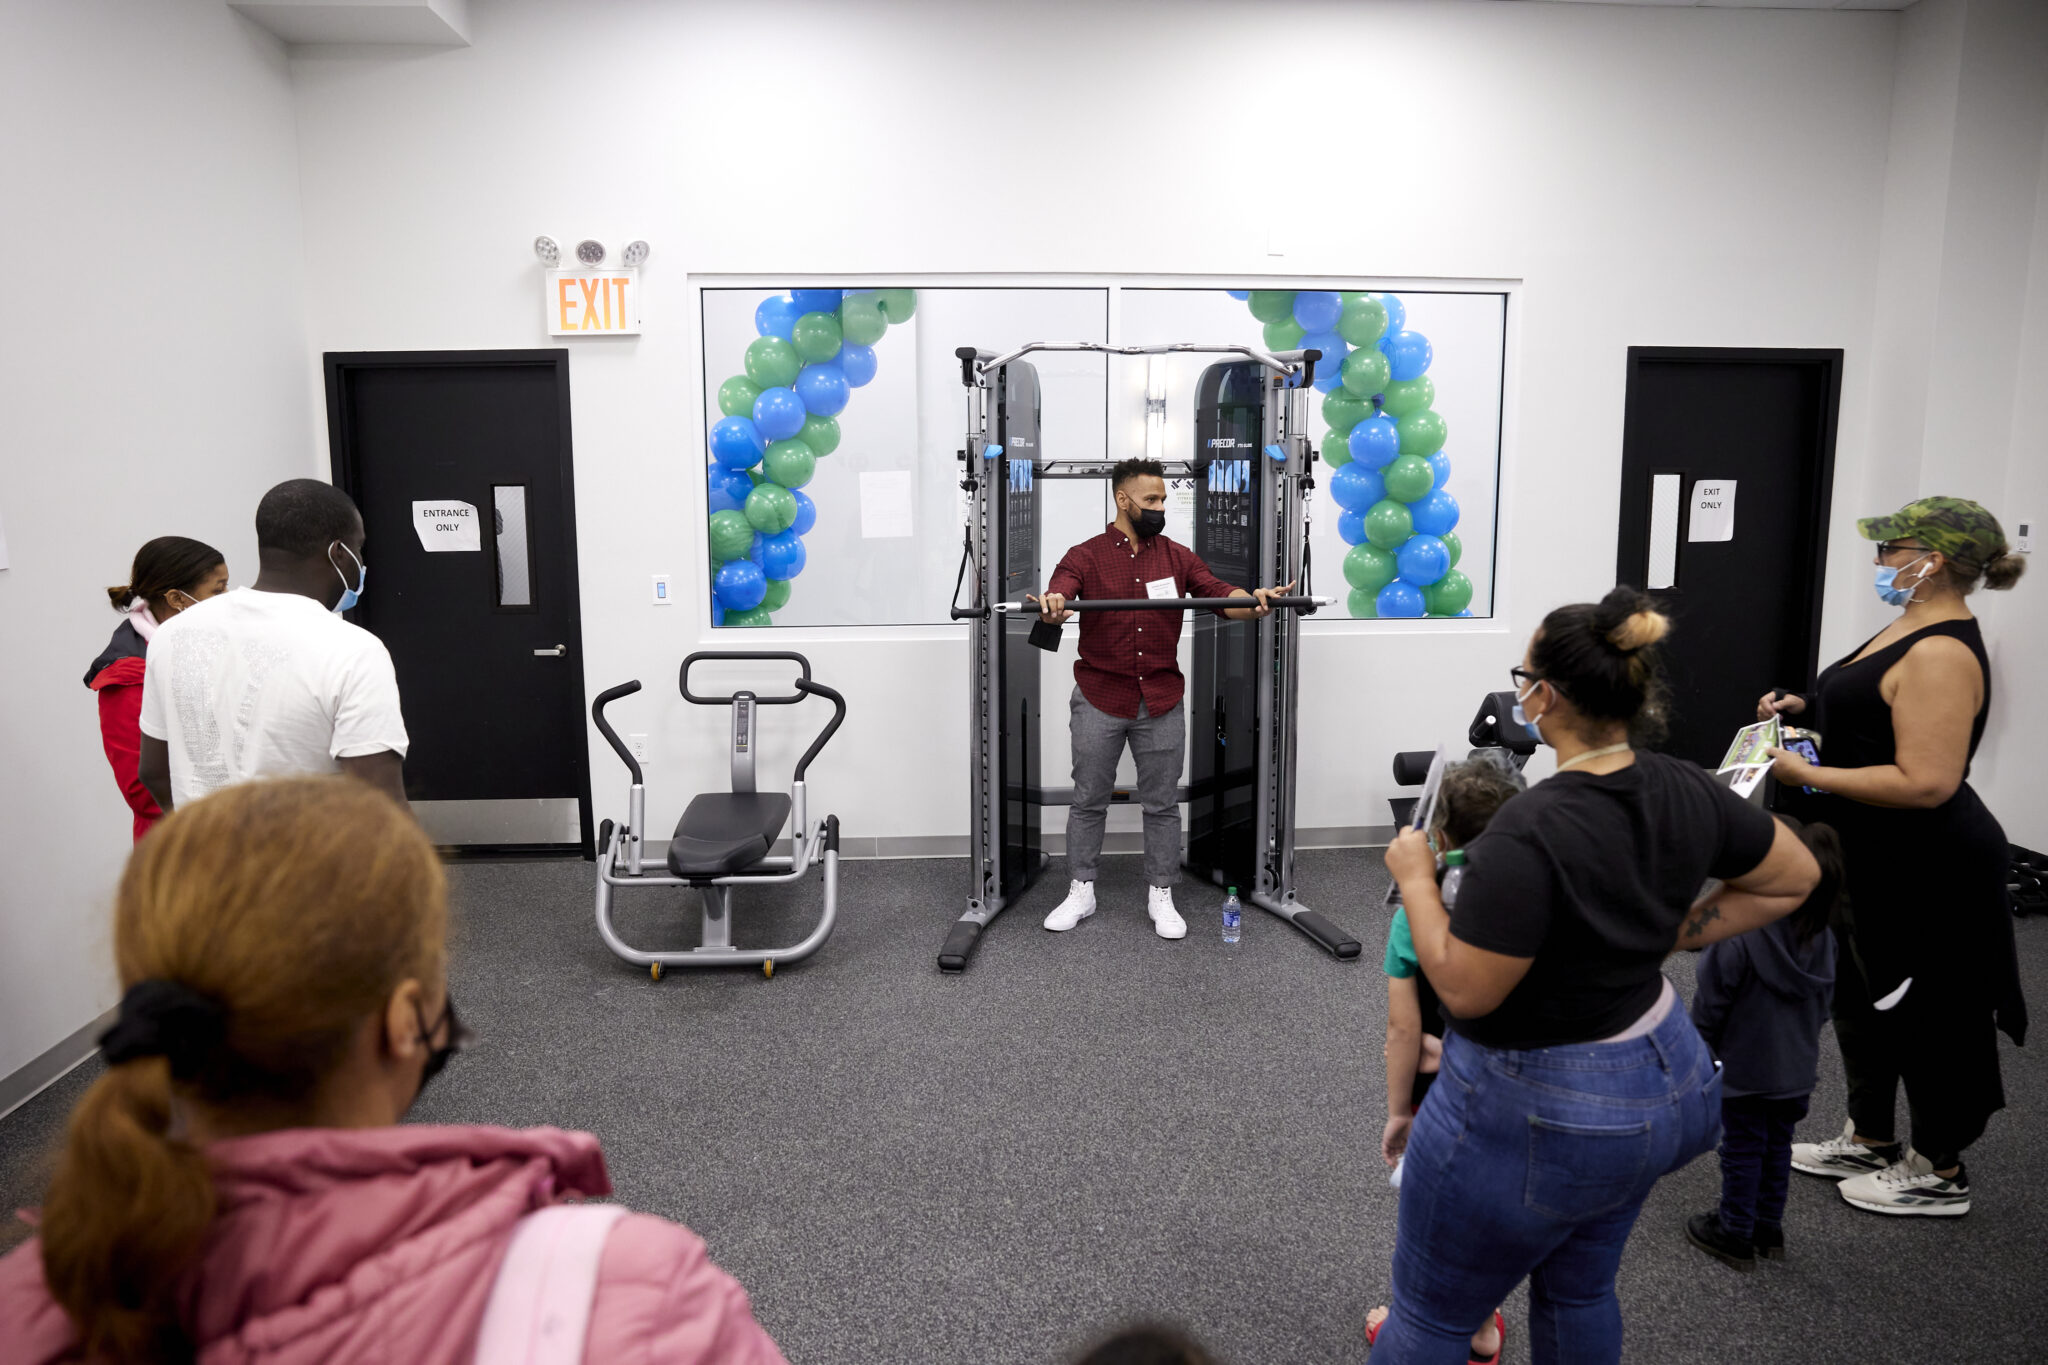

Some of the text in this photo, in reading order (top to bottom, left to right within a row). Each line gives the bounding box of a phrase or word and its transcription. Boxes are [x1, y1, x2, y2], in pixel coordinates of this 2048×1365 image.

[559, 278, 630, 331] EXIT
[1211, 438, 1235, 448] PRECOR
[1703, 488, 1720, 496] EXIT
[423, 509, 470, 517] ENTRANCE
[436, 523, 460, 532] ONLY
